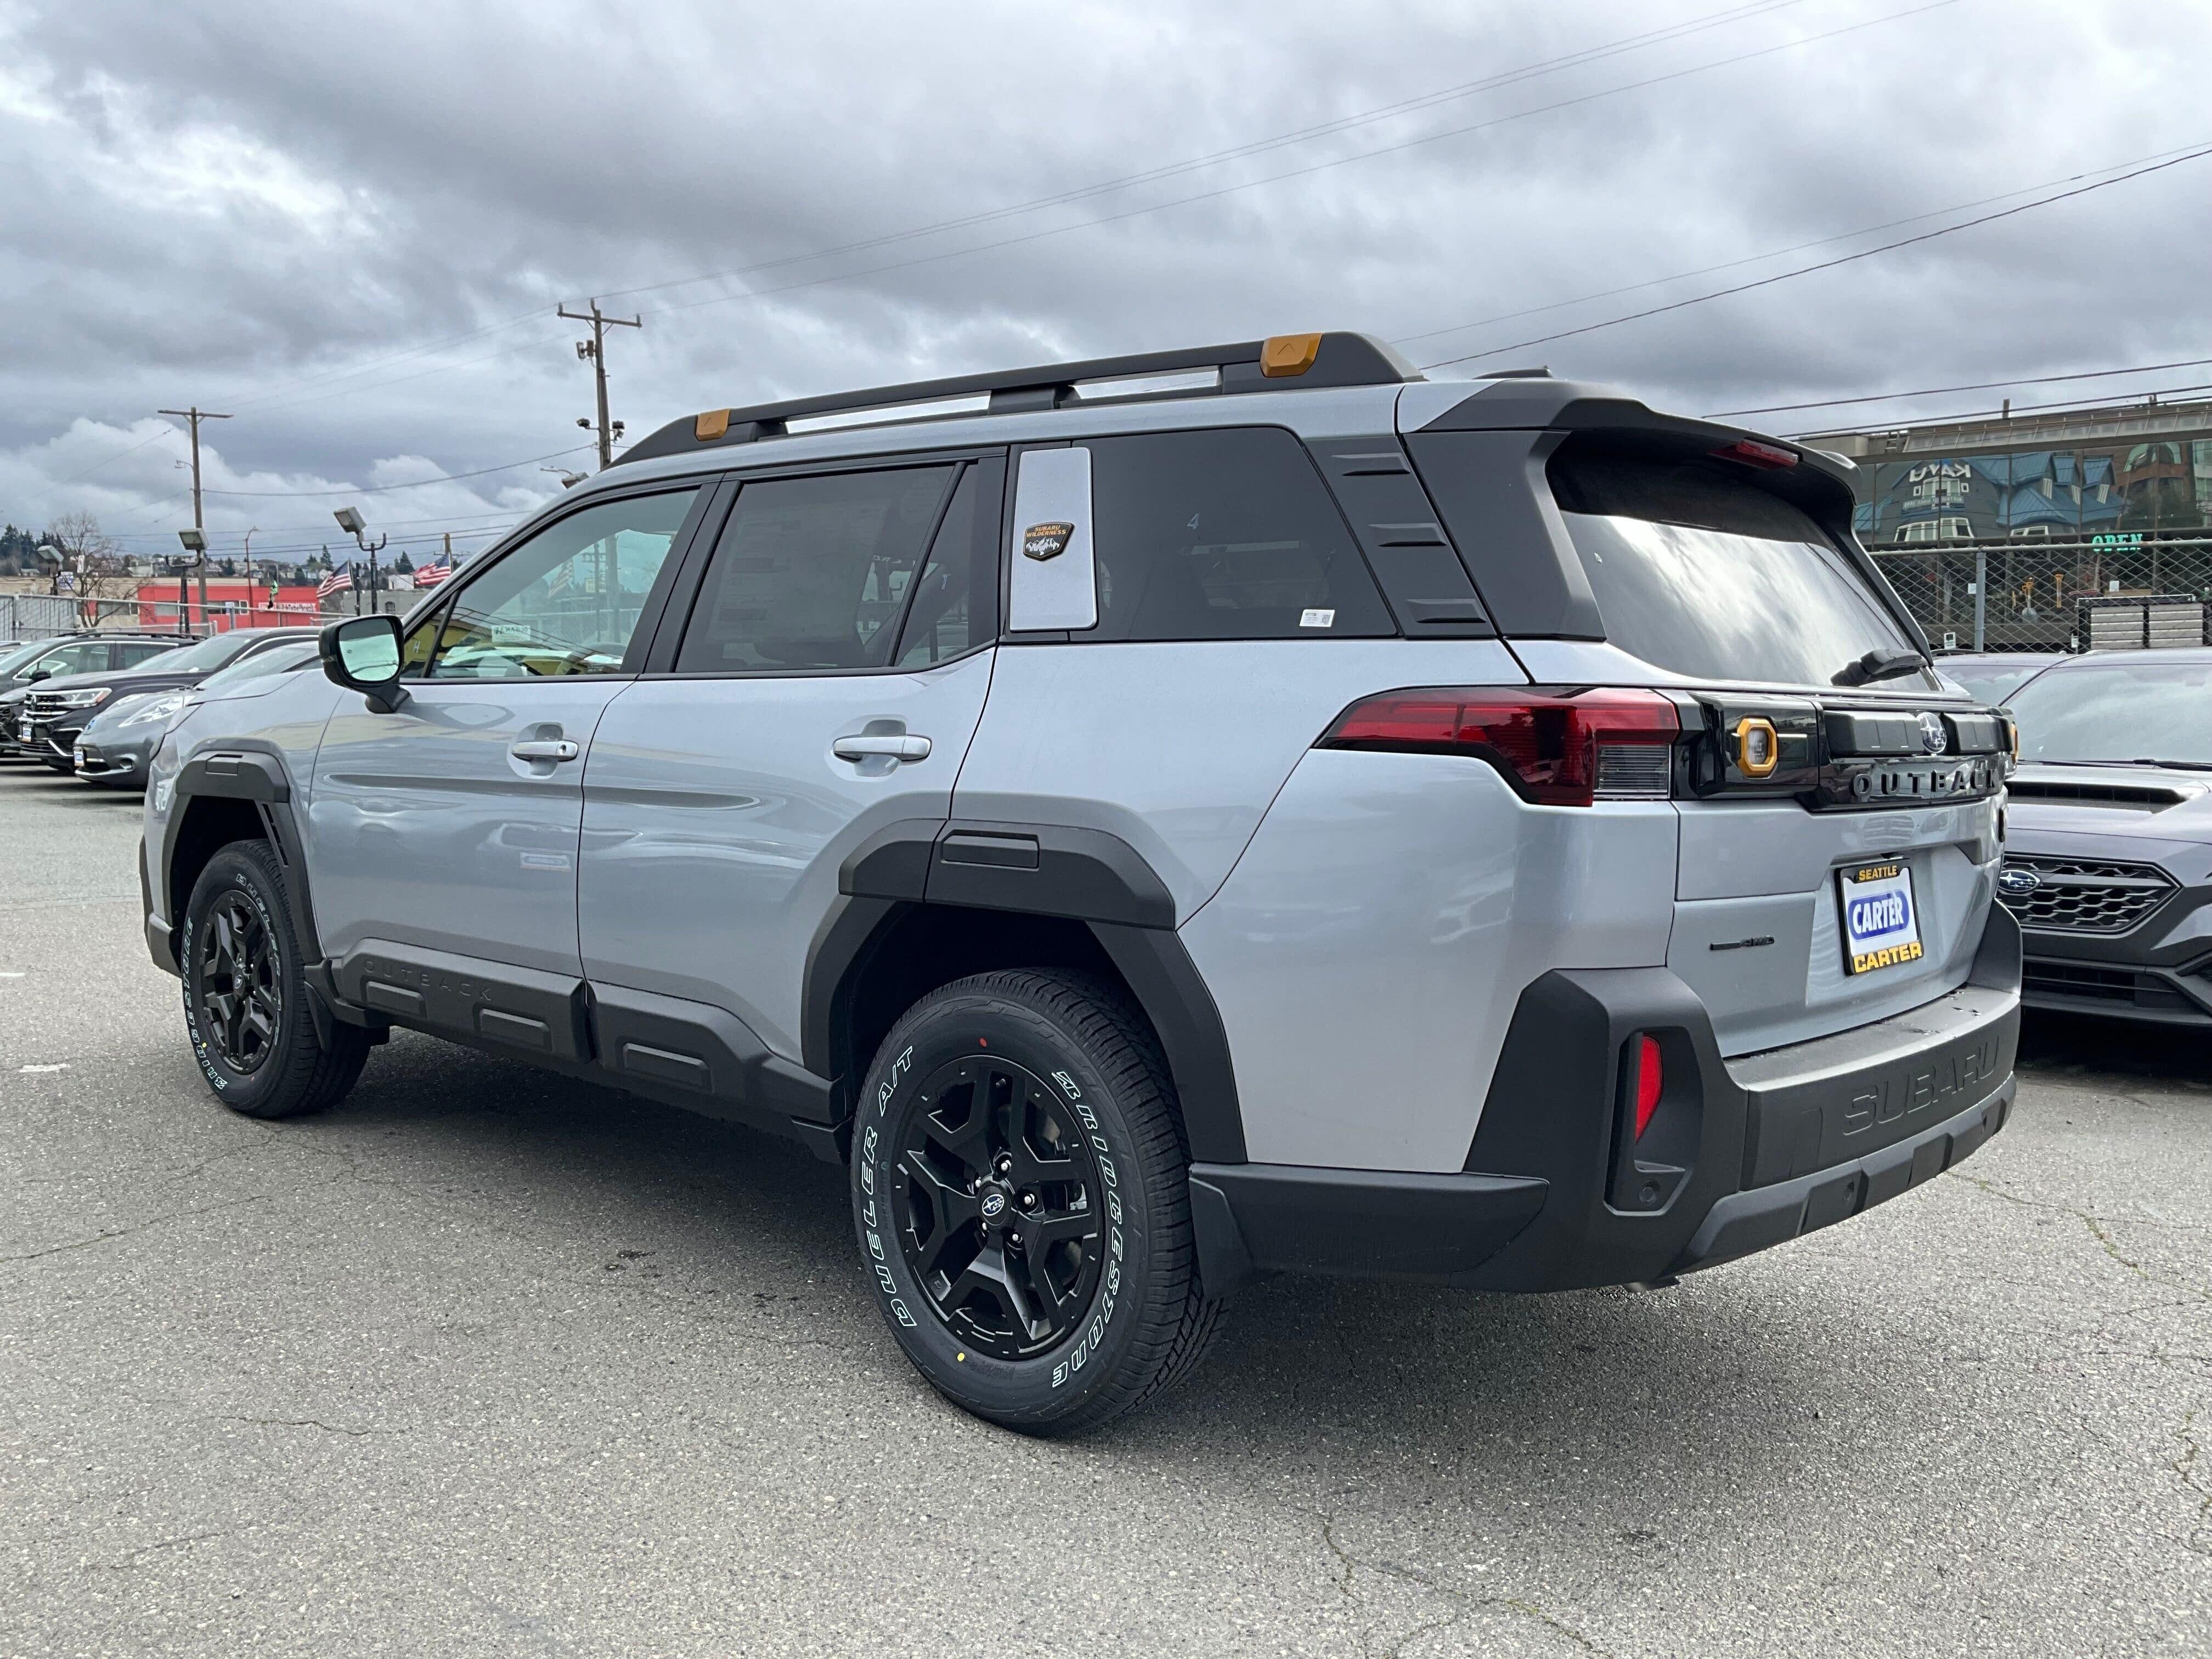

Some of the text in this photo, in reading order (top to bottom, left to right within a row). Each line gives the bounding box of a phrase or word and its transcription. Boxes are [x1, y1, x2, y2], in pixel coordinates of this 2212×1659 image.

[1026, 529, 1066, 538] WILDERNESS
[2092, 533, 2143, 552] OPEN
[1850, 769, 1999, 796] OUTBACK
[1859, 865, 1897, 881] SEATTLE
[1853, 897, 1904, 934] CARTER
[1853, 942, 1922, 973] CARTER
[364, 961, 492, 1001] OUTBACK
[1842, 1035, 2000, 1136] SUBARU
[861, 1126, 917, 1327] DUELER
[1051, 1071, 1123, 1388] BRIDGESTONE
